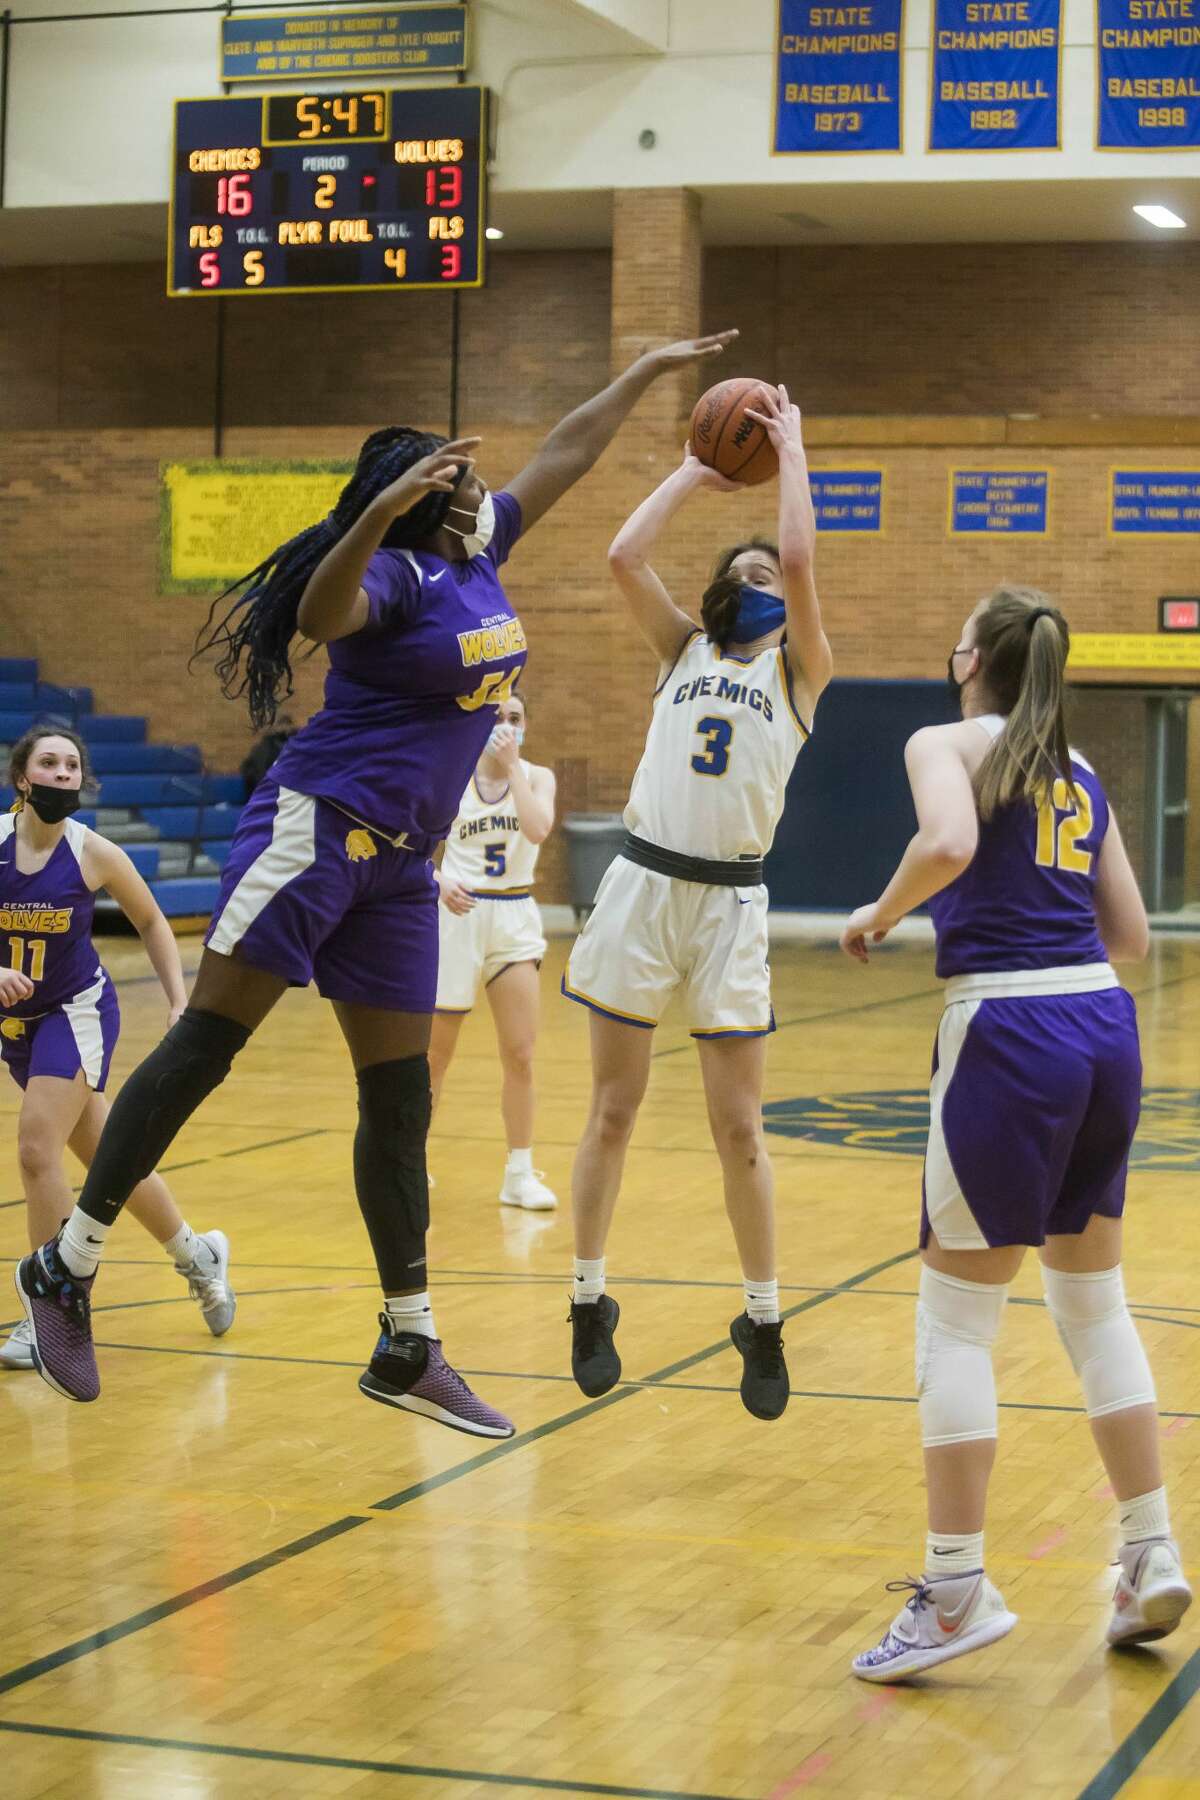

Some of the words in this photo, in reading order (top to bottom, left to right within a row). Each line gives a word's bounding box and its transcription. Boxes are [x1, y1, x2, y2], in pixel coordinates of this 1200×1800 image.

[809, 7, 872, 26] STATE
[966, 2, 1029, 22] STATE
[1128, 0, 1194, 19] STATE
[781, 32, 898, 54] CHAMPIONS
[938, 28, 1056, 50] CHAMPIONS
[1102, 27, 1200, 48] CHAMPION
[785, 83, 892, 104] BASEBALL
[941, 80, 1049, 101] BASEBALL
[1108, 77, 1200, 98] BASEBAL
[296, 95, 384, 139] 5:47
[189, 147, 261, 172] CHEMICS
[302, 155, 348, 171] PERIOD
[394, 139, 464, 163] WOLVES
[217, 173, 253, 217] 16
[315, 174, 337, 209] 2
[425, 166, 463, 208] 13
[189, 225, 224, 248] FLS
[329, 219, 374, 242] FOUL
[429, 216, 464, 240] FLS
[199, 252, 221, 287] 5
[243, 251, 265, 286] 5
[384, 247, 407, 278] 4
[441, 244, 462, 279] 3
[480, 612, 511, 627] CENTRAL
[673, 675, 773, 722] CHEMICS
[690, 714, 736, 779] 3
[460, 815, 520, 840] CHEMIC
[1030, 776, 1093, 876] 12
[484, 843, 507, 878] 5
[2, 901, 54, 910] CENTRAL
[0, 907, 74, 933] OLVES
[9, 936, 47, 982] 11
